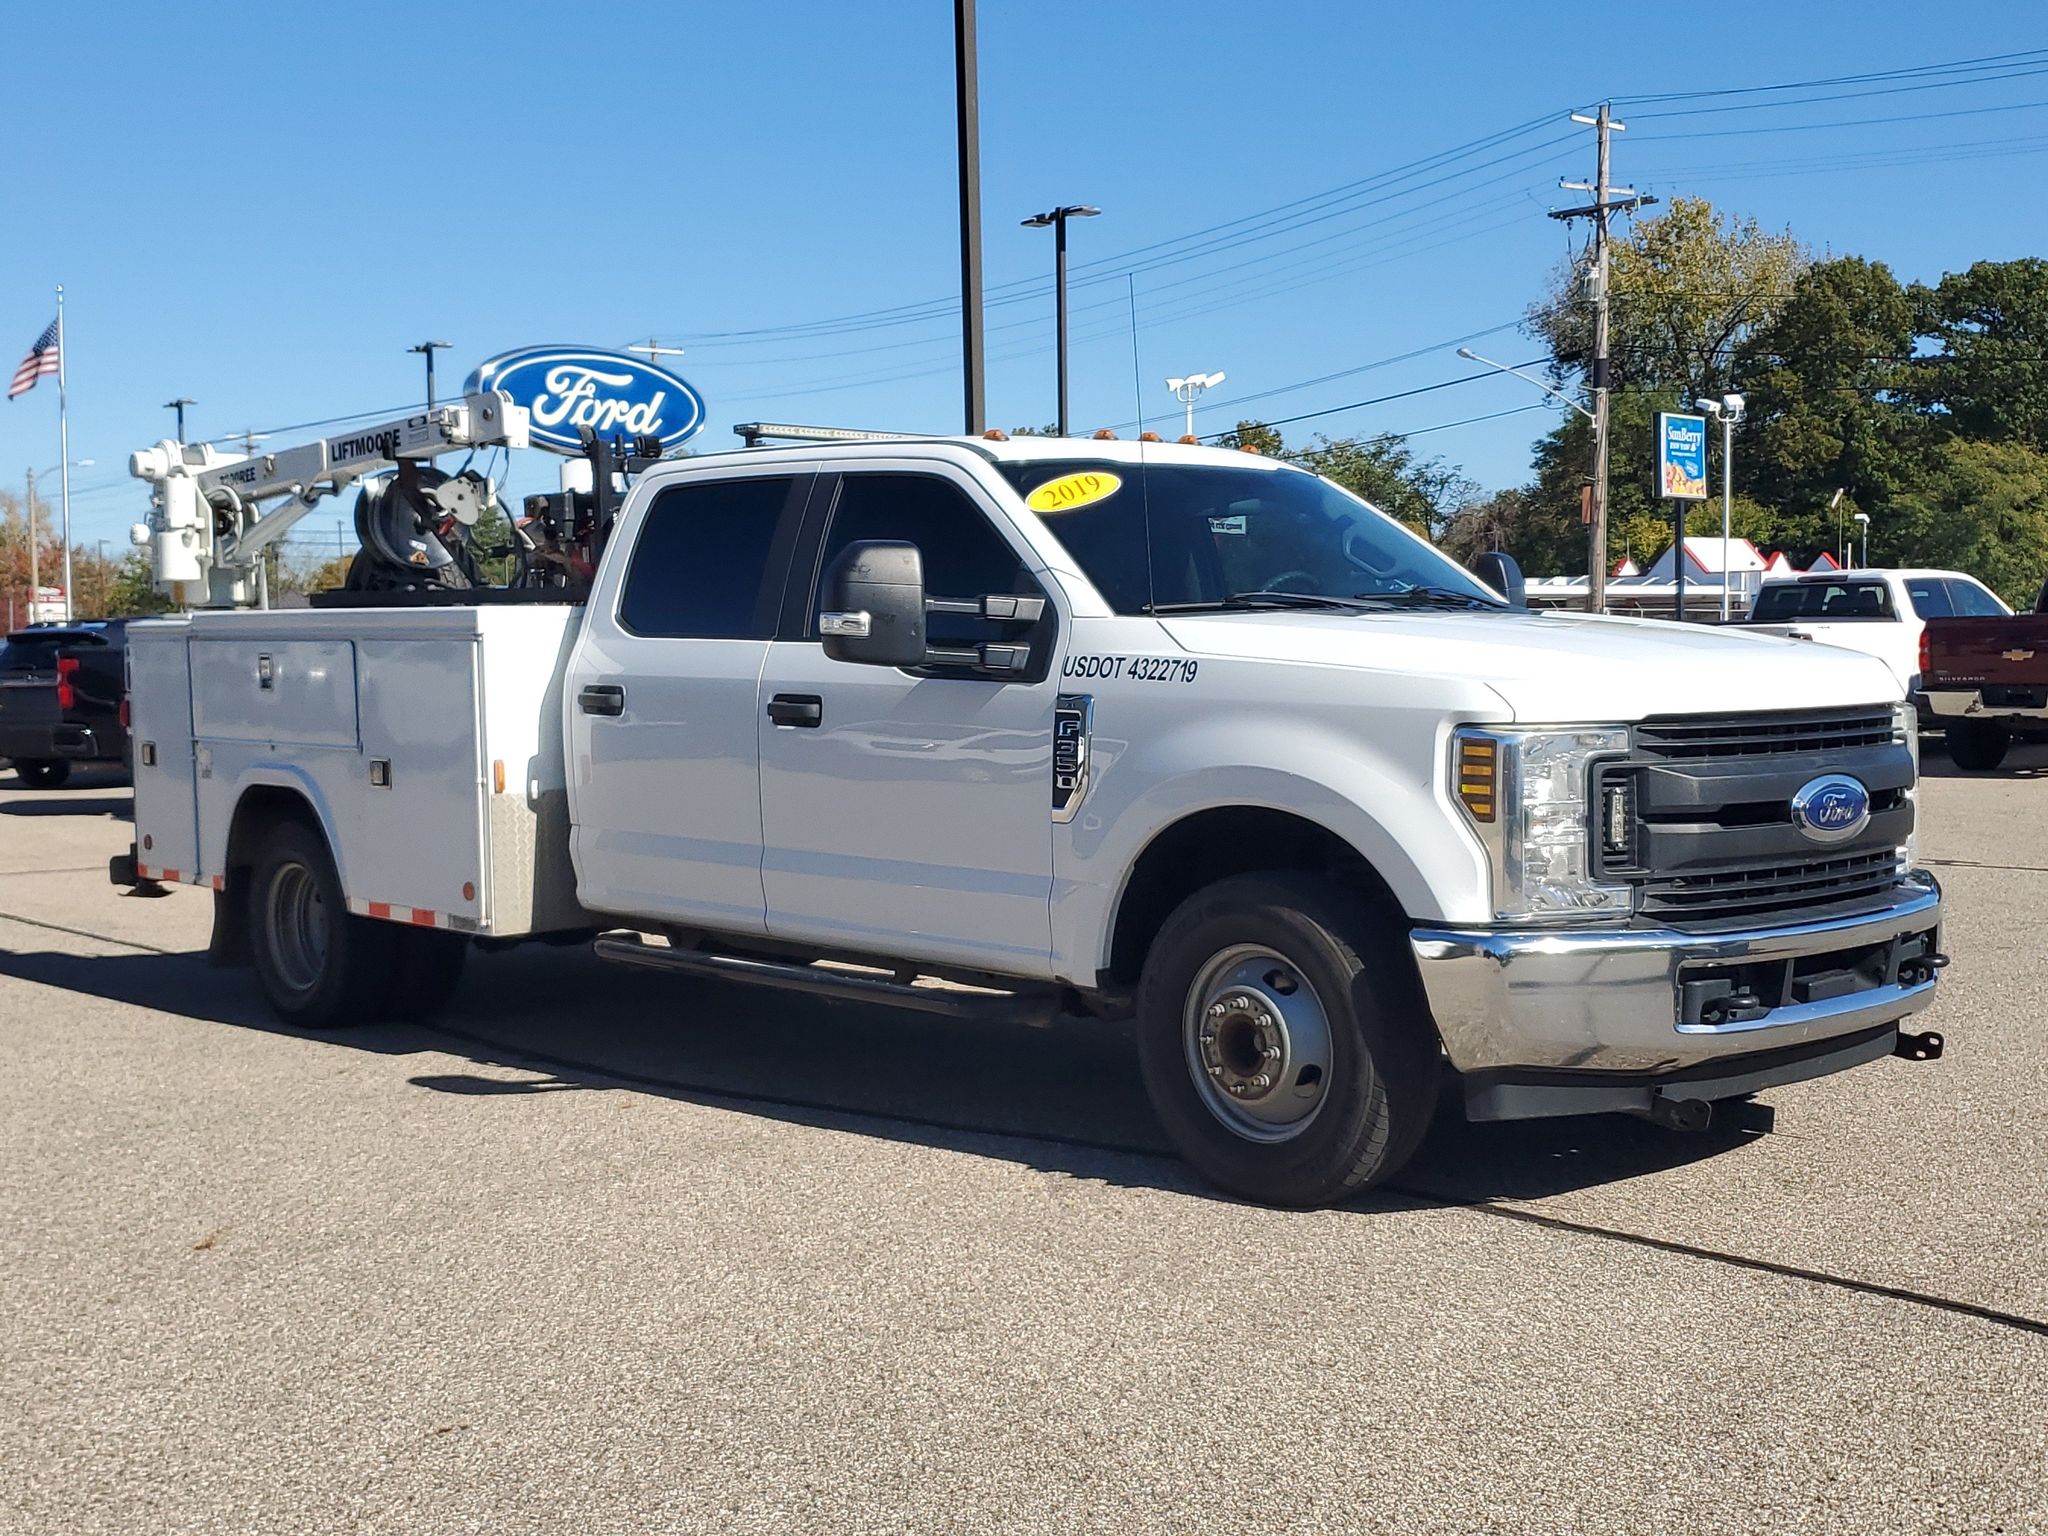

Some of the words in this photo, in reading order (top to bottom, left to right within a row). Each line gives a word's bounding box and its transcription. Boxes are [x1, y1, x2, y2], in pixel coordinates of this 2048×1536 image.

[532, 365, 666, 435] Ford
[1043, 475, 1100, 507] 2019
[1062, 656, 1126, 679] USDOT
[1127, 657, 1198, 683] 4322719
[1819, 793, 1855, 823] Ford
